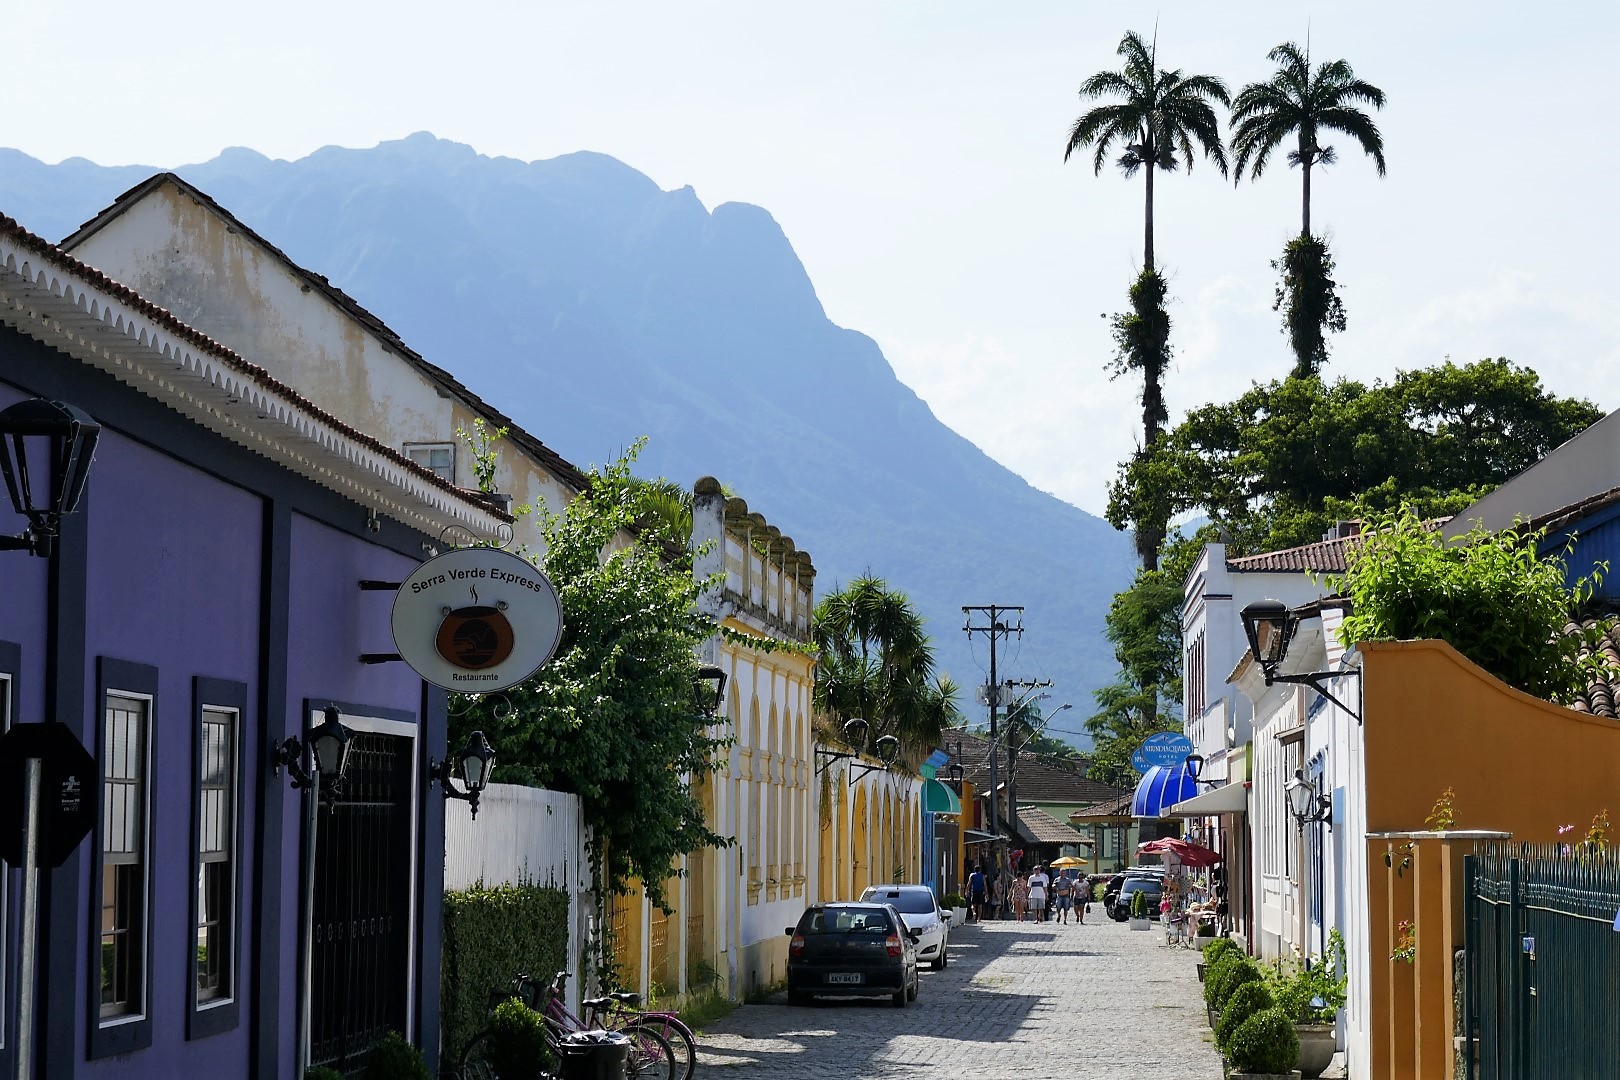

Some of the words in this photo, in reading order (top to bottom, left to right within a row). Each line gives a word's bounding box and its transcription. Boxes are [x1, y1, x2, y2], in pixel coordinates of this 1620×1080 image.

[411, 574, 446, 594] Serra
[448, 567, 486, 581] Verde
[490, 568, 542, 593] Express
[452, 673, 499, 682] Restaurante
